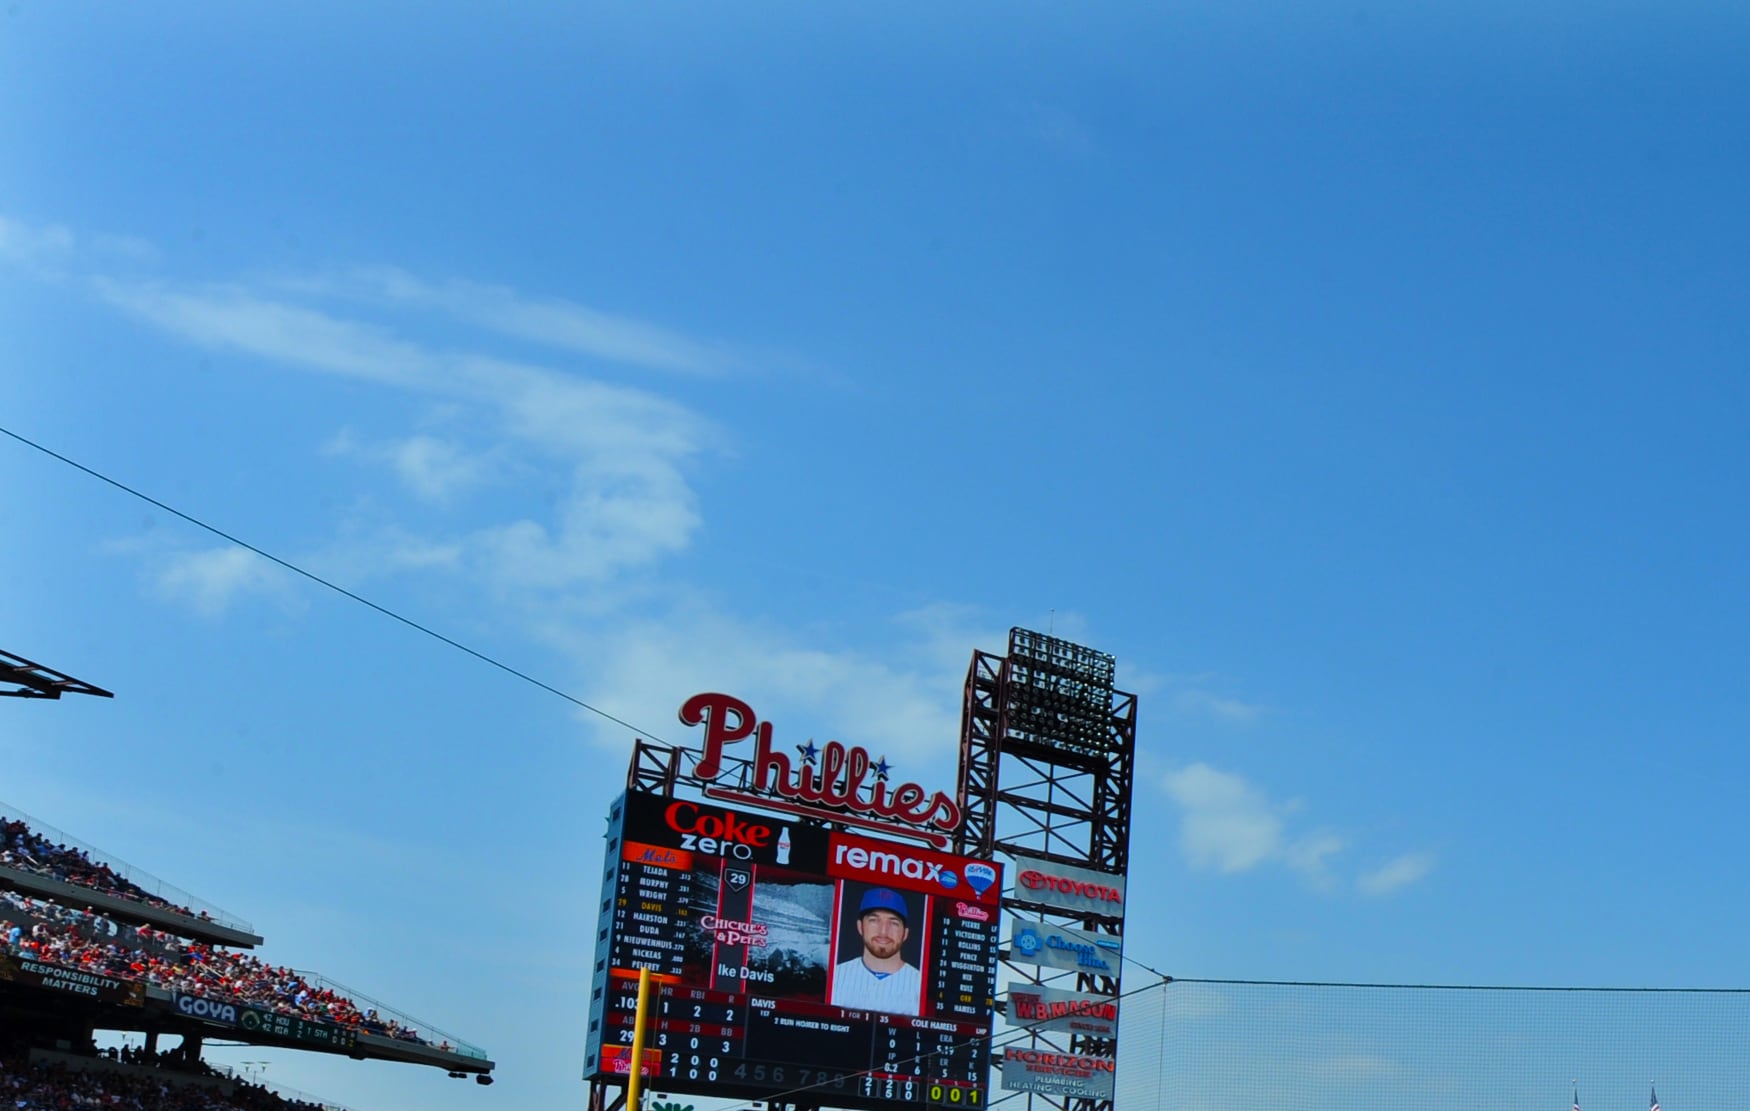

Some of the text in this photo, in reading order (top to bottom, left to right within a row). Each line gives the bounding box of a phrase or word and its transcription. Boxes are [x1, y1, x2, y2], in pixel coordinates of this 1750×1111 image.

[678, 692, 961, 834] Phillies
[665, 802, 770, 847] Coke
[680, 834, 752, 859] zero
[836, 844, 943, 882] remax
[643, 867, 668, 877] TEJADA
[730, 873, 747, 884] 29
[639, 877, 668, 889] MURPHY
[1046, 875, 1121, 904] TOYOTA
[639, 889, 667, 900] WRIGHT
[641, 901, 662, 912] DAVIS
[633, 912, 668, 924] HAIRSTON
[639, 925, 659, 935] DUDA
[955, 930, 985, 942] VICTORINO
[958, 942, 981, 951] ROLLINS
[632, 949, 662, 960] NICKEAS
[20, 961, 120, 990] RESPONSIBILITY
[718, 964, 775, 983] Ike Davis
[42, 976, 98, 996] MATTERS
[690, 990, 705, 1000] RBI
[179, 996, 236, 1022] GOYA
[751, 999, 776, 1009] DAVIS
[663, 1002, 669, 1013] 1
[694, 1006, 701, 1017] 2
[726, 1010, 734, 1021] 2
[795, 1020, 819, 1029] HOMER
[821, 1021, 829, 1030] TO
[830, 1023, 850, 1033] RIGHT
[912, 1019, 928, 1029] COLE
[620, 1030, 730, 1052] 29 3 0 3
[670, 1053, 718, 1068] 2 0 0
[1004, 1047, 1114, 1073] HORIZON
[670, 1068, 717, 1081] 1 0 0
[1035, 1075, 1084, 1087] PLUMBING
[931, 1086, 960, 1101] 0 0
[1009, 1081, 1106, 1098] HEATING COOLING
